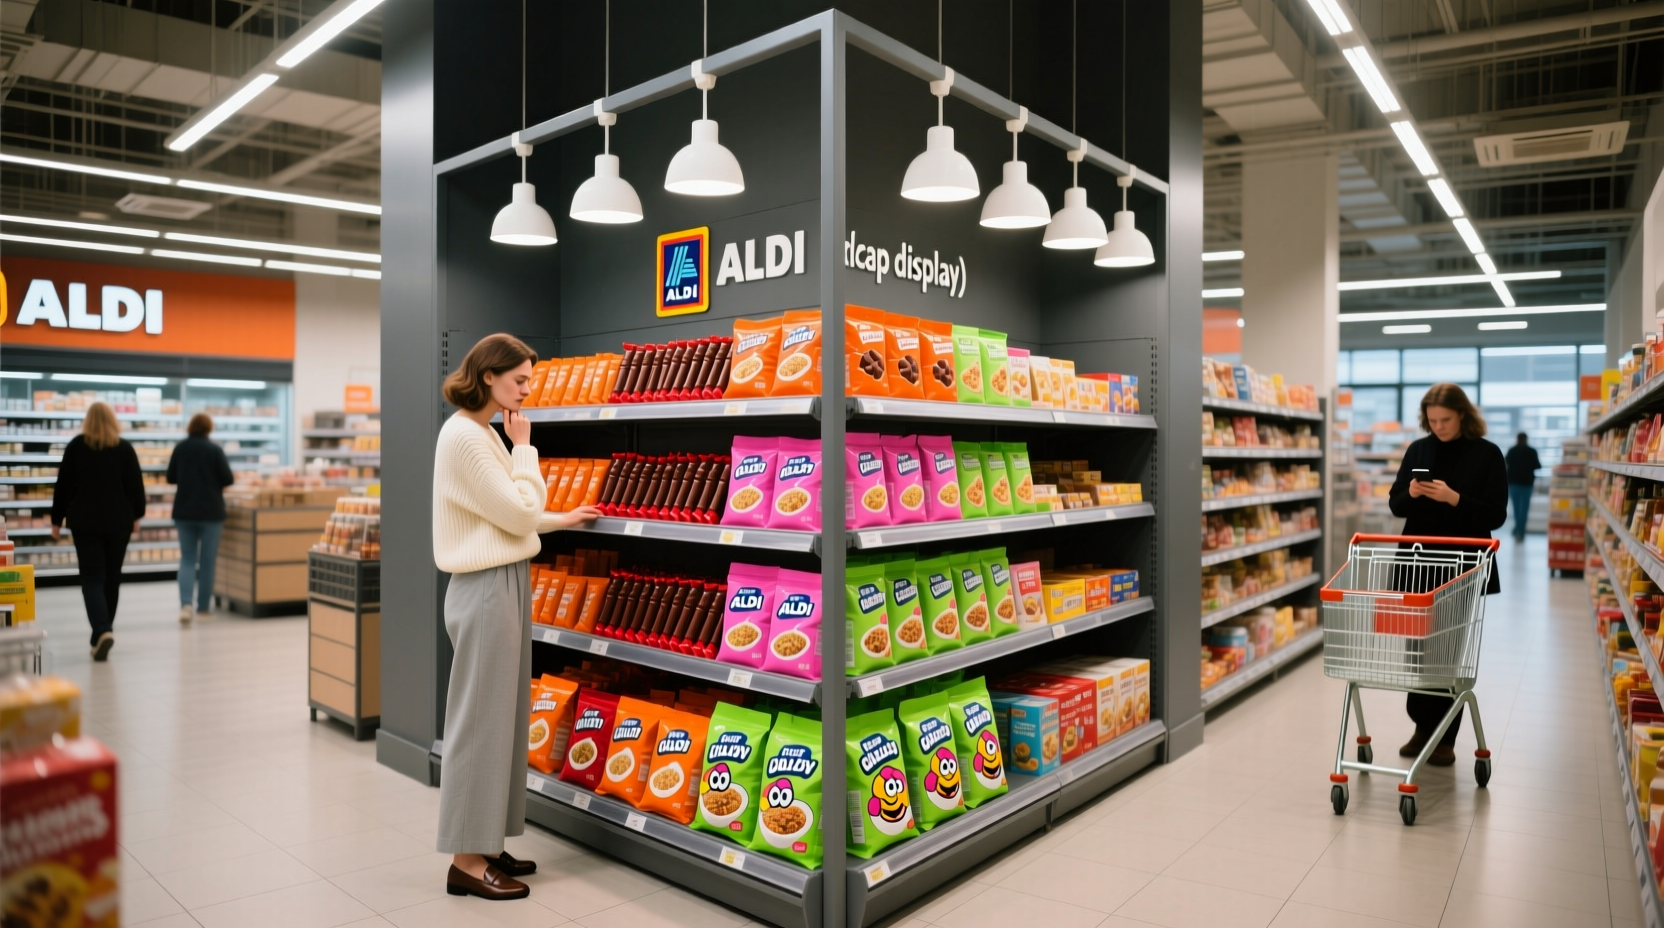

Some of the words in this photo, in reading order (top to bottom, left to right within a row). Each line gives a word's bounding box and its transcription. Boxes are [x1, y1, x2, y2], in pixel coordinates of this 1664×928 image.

[716, 230, 804, 286] ALDI
[894, 242, 967, 298] display)
[16, 279, 163, 335] ALDI
[665, 284, 698, 302] ALDI
[730, 595, 763, 610] ALDI
[778, 602, 813, 616] ALDI
